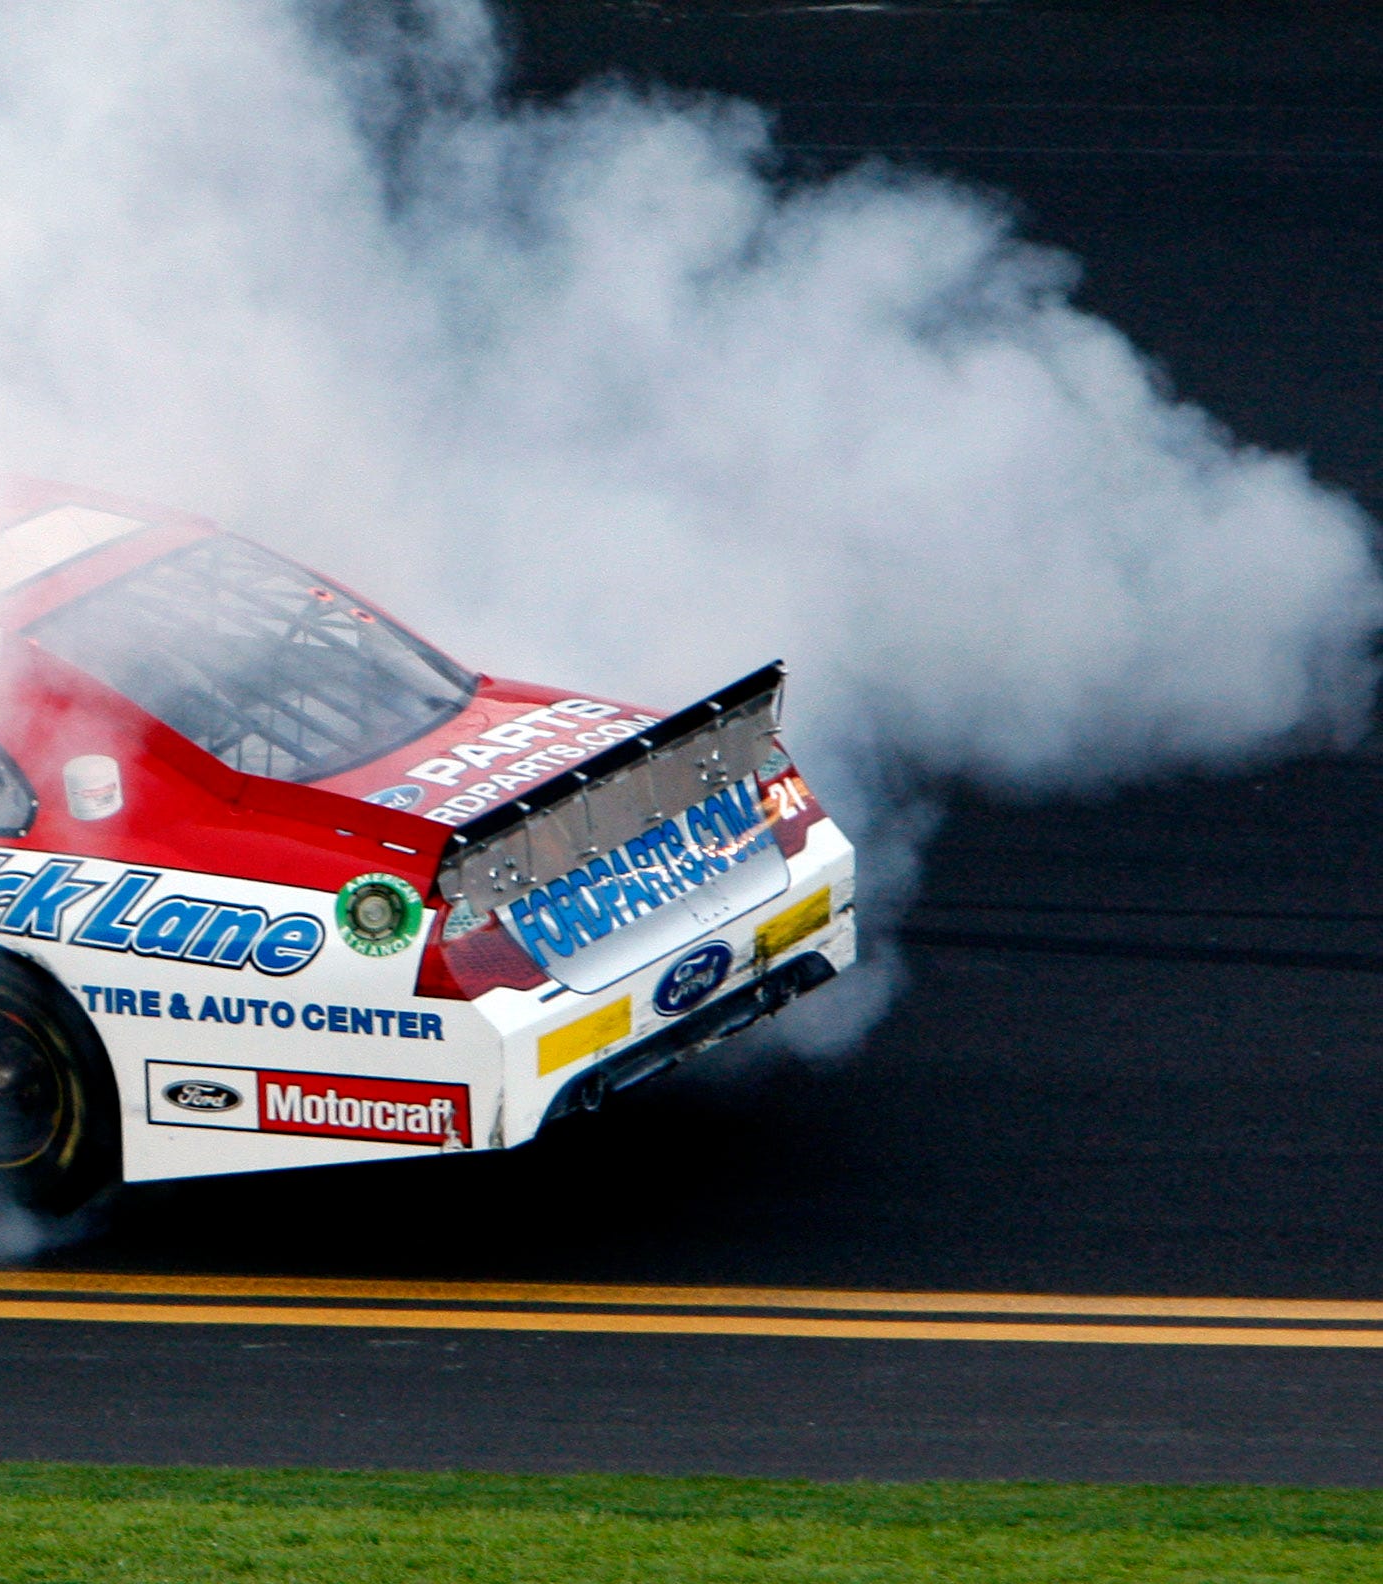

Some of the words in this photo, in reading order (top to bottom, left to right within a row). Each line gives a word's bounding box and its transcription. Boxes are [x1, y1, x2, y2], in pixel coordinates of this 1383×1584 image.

[404, 698, 621, 787] PARTS
[768, 776, 808, 820] 21
[509, 780, 777, 968] FORDPARTS.COM
[73, 868, 327, 977] Lane
[81, 985, 161, 1018] TIRE
[169, 993, 193, 1020] &
[199, 996, 295, 1028] AUTO
[301, 1003, 445, 1041] CENTER
[265, 1083, 455, 1135] Motorcraft
